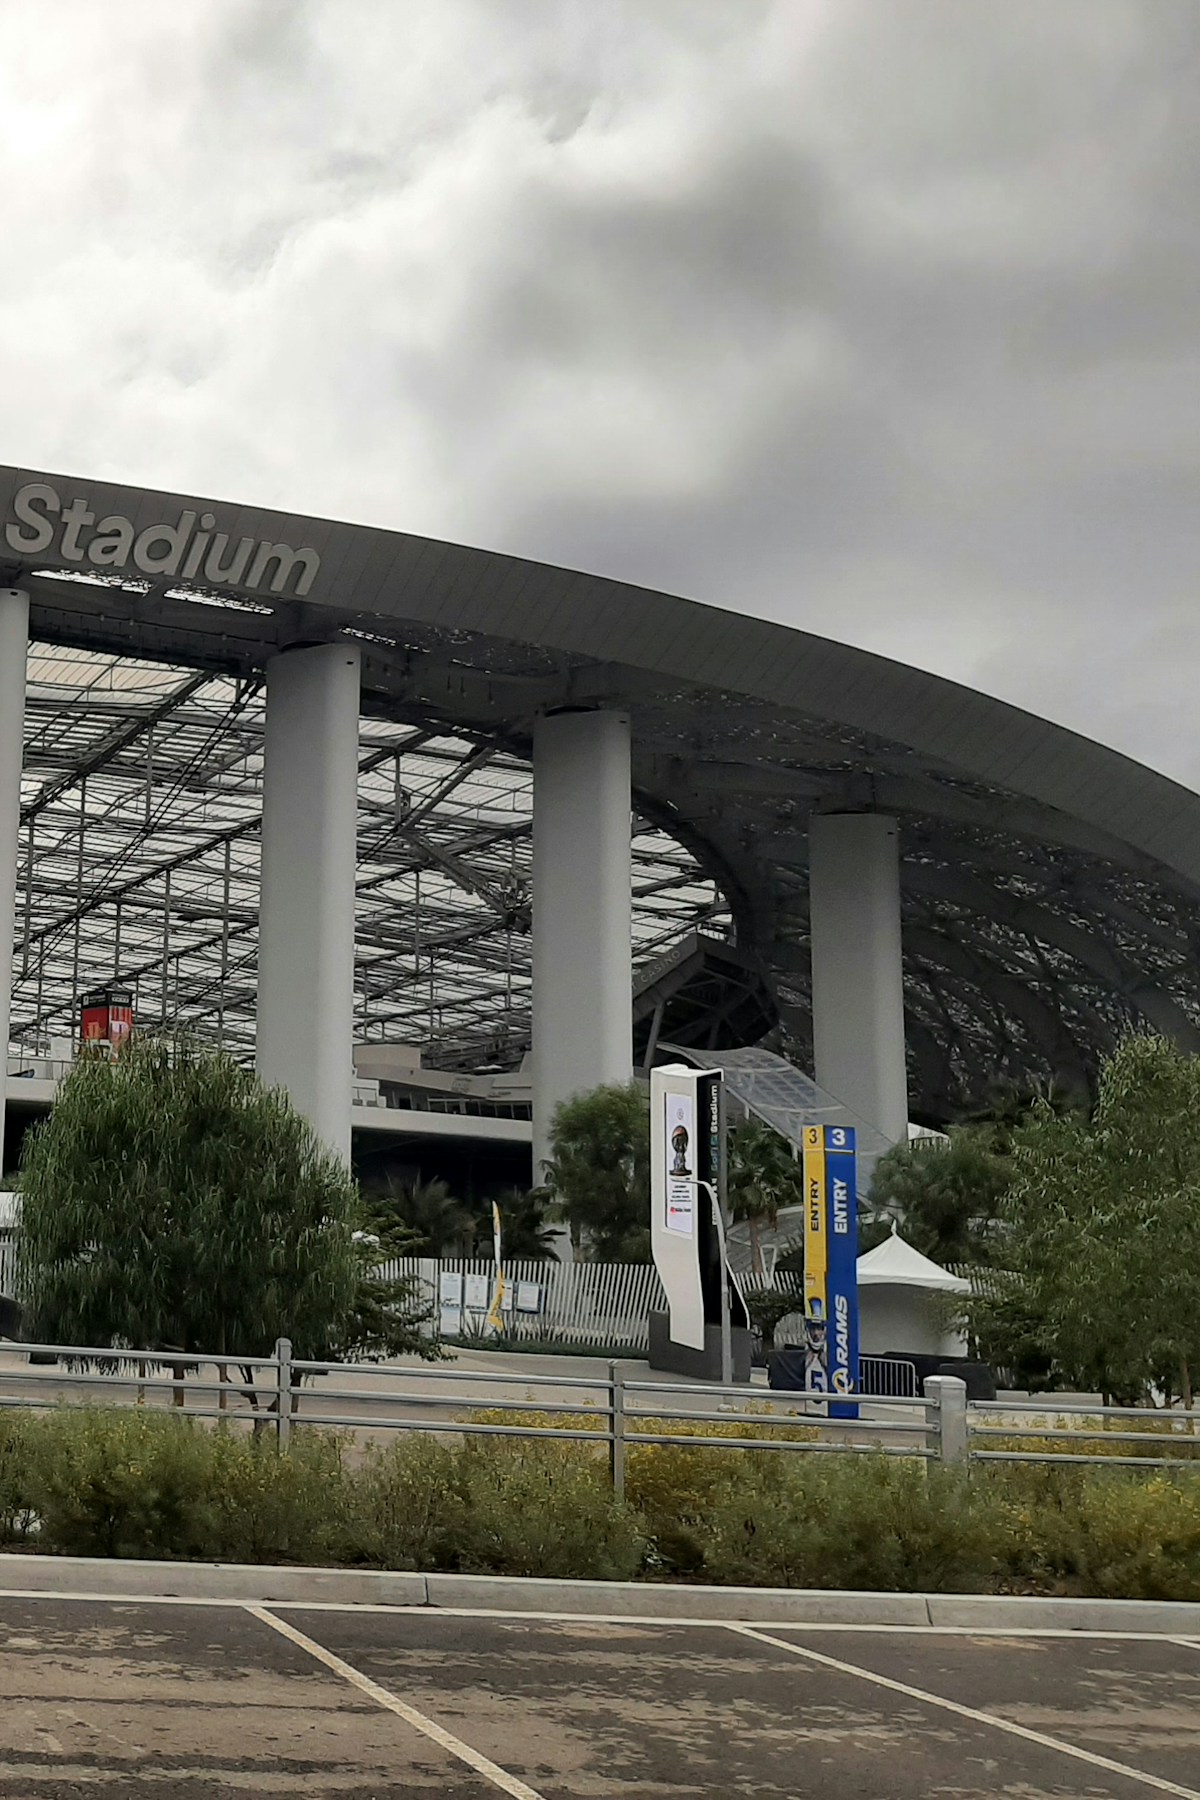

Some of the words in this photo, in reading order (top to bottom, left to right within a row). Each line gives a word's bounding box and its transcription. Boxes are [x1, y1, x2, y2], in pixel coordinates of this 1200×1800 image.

[5, 483, 322, 596] Stadium
[709, 1085, 718, 1134] Stadium
[809, 1128, 818, 1144] 3
[832, 1128, 846, 1146] 3
[810, 1178, 819, 1231] ENTRY
[833, 1177, 848, 1233] ENTRY
[835, 1294, 848, 1366] RAMS
